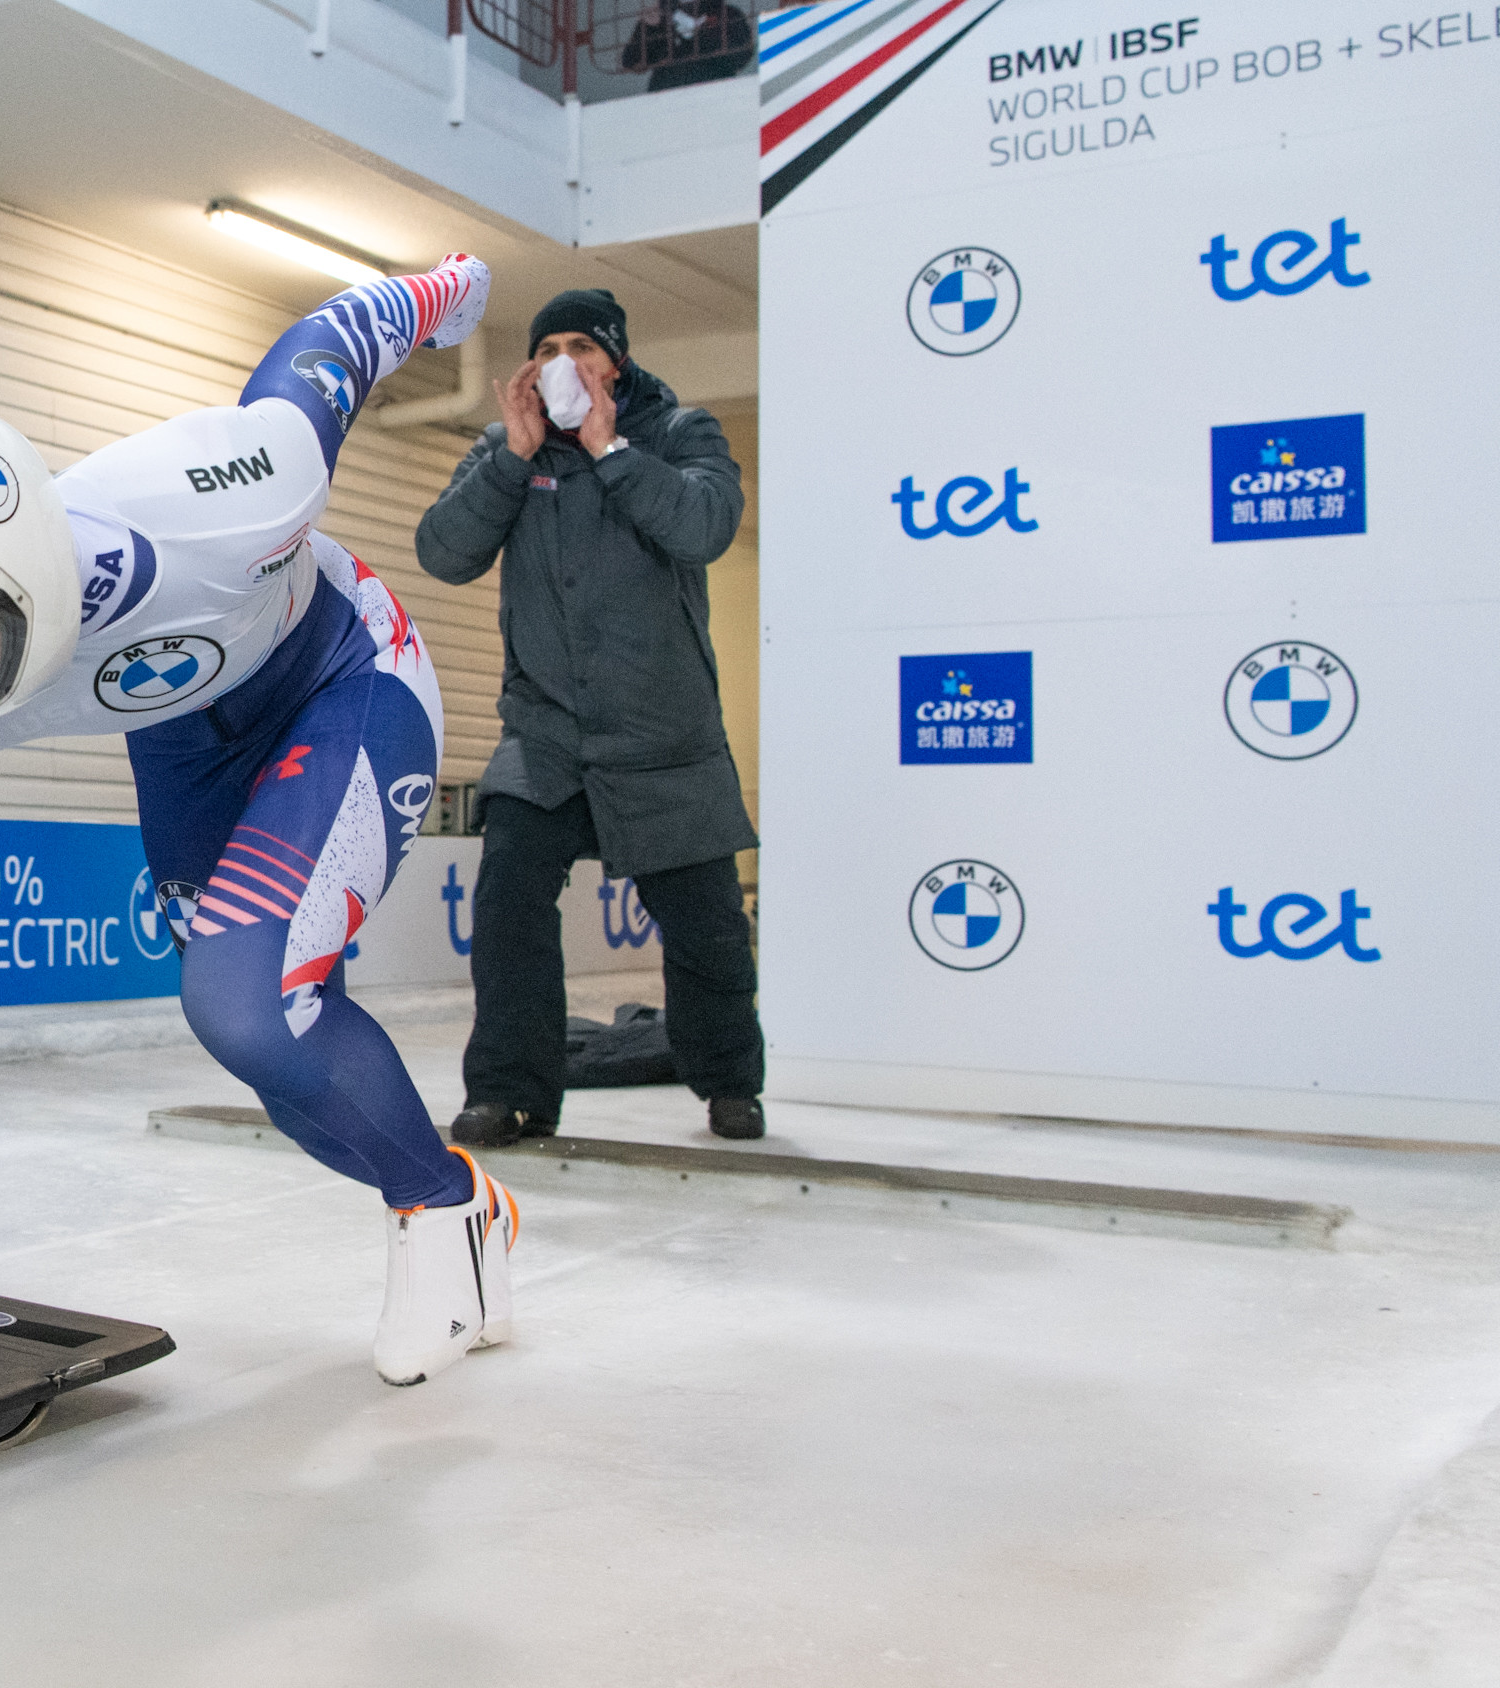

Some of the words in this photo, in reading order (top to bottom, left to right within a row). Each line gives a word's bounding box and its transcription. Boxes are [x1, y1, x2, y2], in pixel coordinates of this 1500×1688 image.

[988, 75, 1127, 125] WORLD
[1139, 57, 1220, 100] CUP
[1232, 39, 1323, 84] BOB
[1378, 6, 1500, 59] SKEL
[989, 40, 1083, 83] BMW
[1110, 18, 1199, 60] IBSF
[989, 113, 1157, 167] SIGULDA
[1200, 217, 1372, 302] tet
[185, 446, 276, 494] BMW
[1230, 466, 1346, 496] caissa
[891, 466, 1040, 541] tet
[80, 548, 125, 626] USA
[101, 638, 186, 683] BMW
[916, 699, 1016, 722] caissa
[1206, 886, 1382, 963] tet
